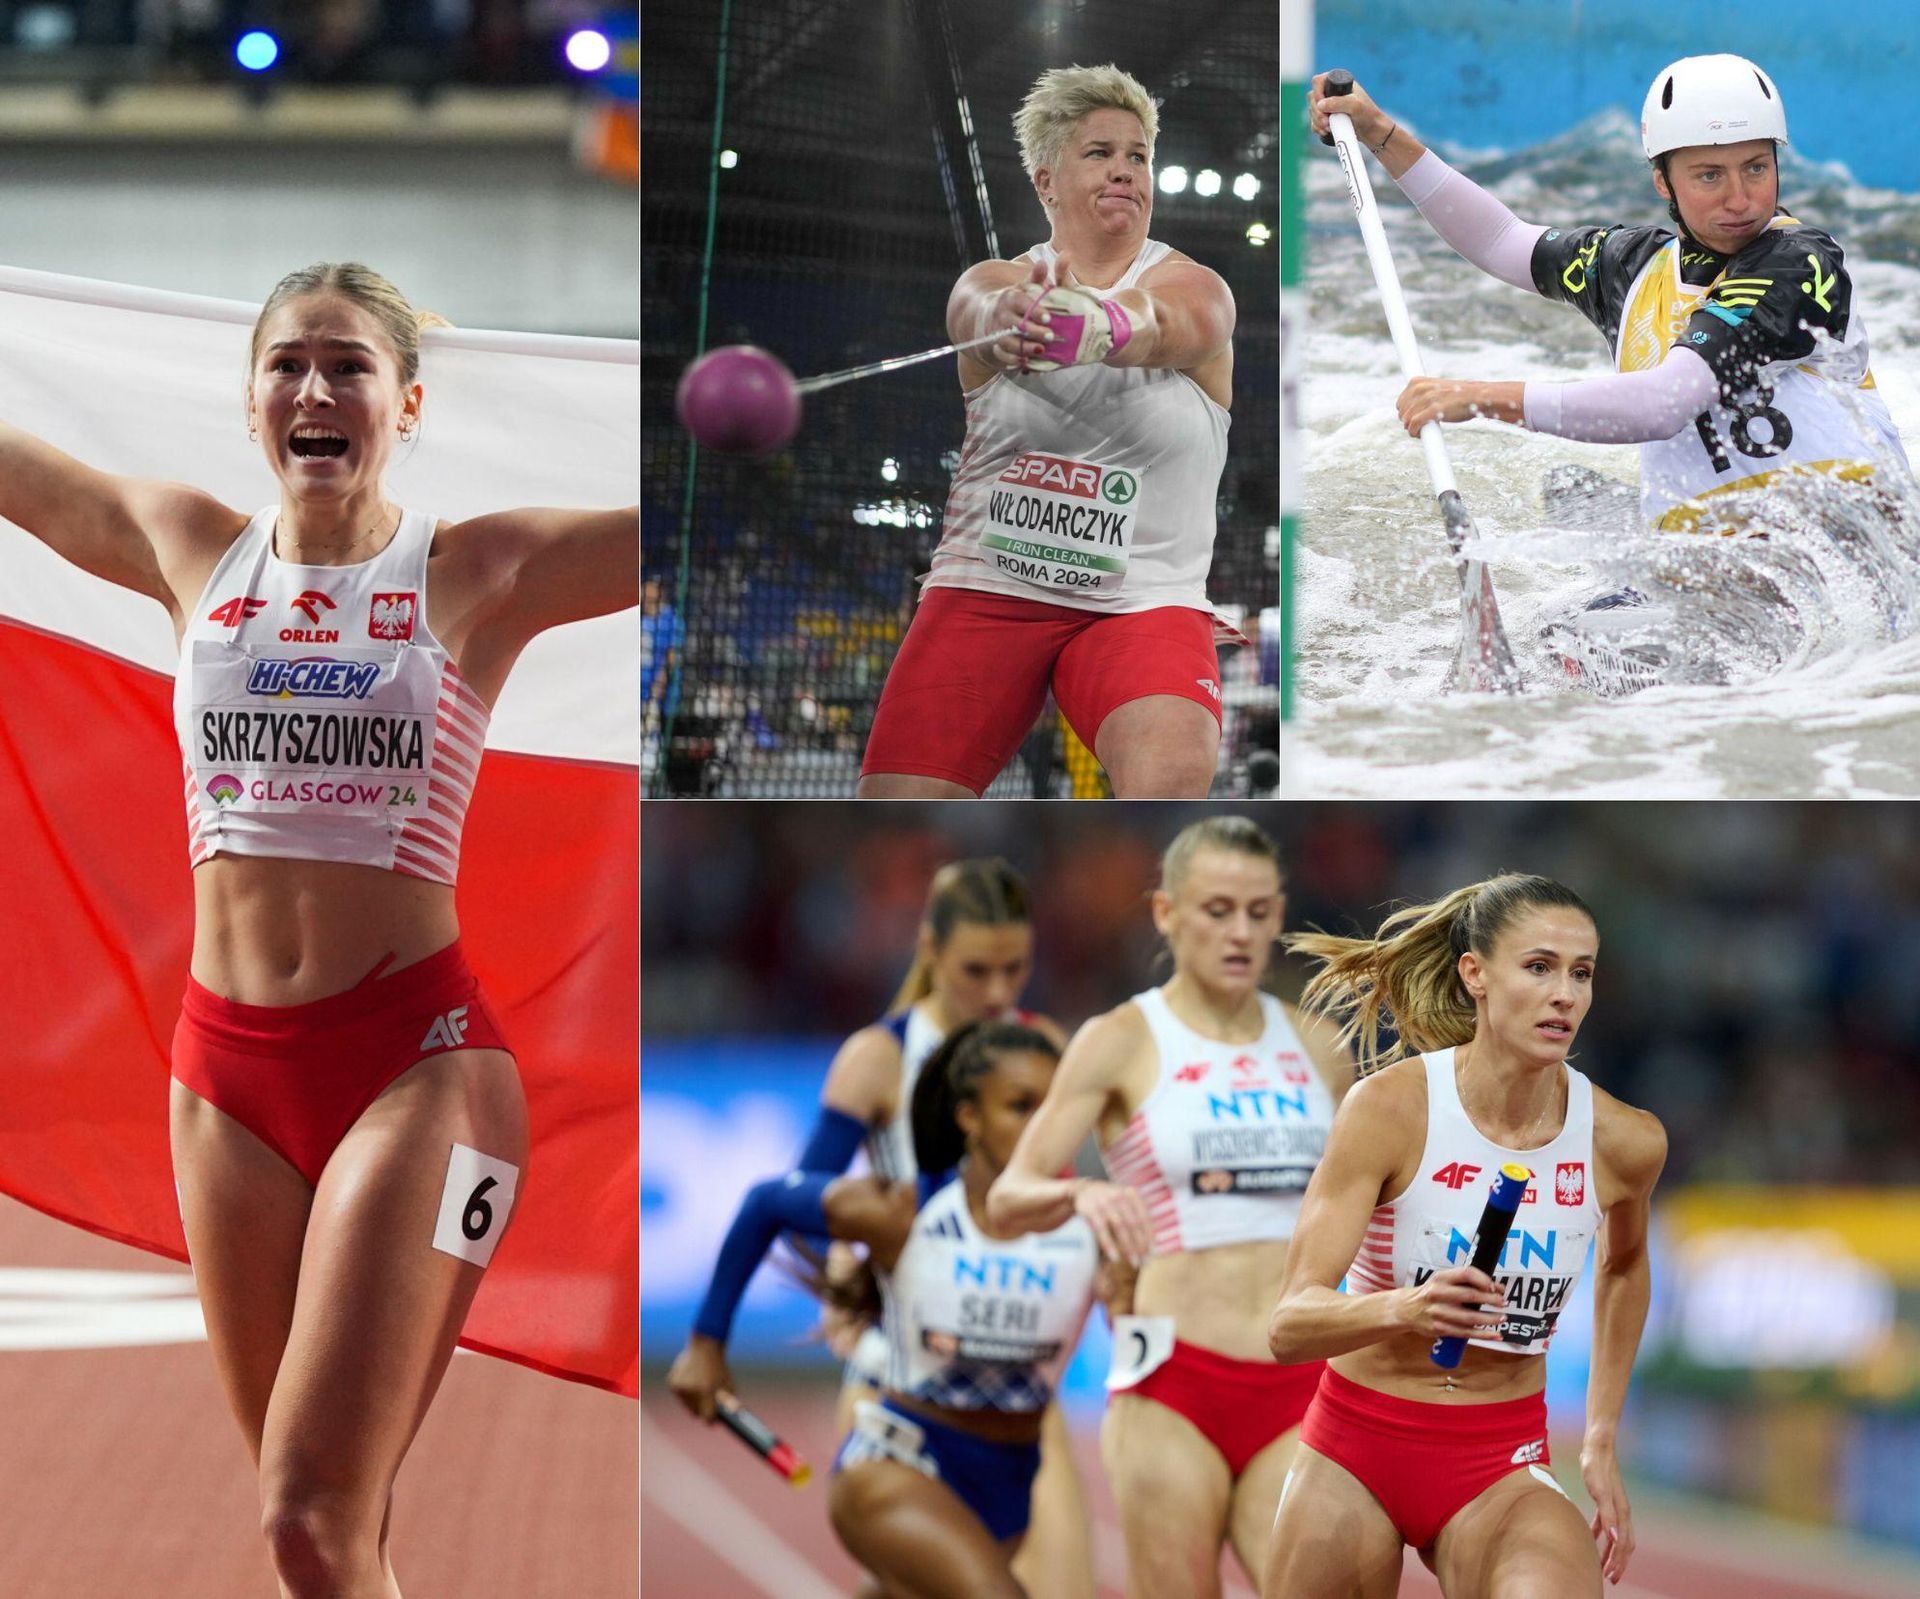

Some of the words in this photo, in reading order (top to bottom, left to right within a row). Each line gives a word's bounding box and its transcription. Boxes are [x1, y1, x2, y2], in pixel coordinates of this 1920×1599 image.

[1003, 458, 1098, 494] SPAR
[989, 490, 1128, 547] WŁODARCZYK
[1012, 542, 1041, 558] RUN
[996, 554, 1050, 582] ROMA
[1053, 568, 1102, 589] 2024
[279, 628, 339, 643] ORLEN
[248, 660, 380, 699] HI-CHEW
[202, 710, 424, 770] SKRZYSZOWSKA
[250, 780, 383, 805] GLASGOW
[387, 785, 417, 806] 24
[1207, 1086, 1308, 1121] NTN
[1432, 1162, 1483, 1190] 4F
[461, 1175, 499, 1241] 6
[954, 1254, 1056, 1294] NTN
[960, 1295, 1041, 1332] SERI
